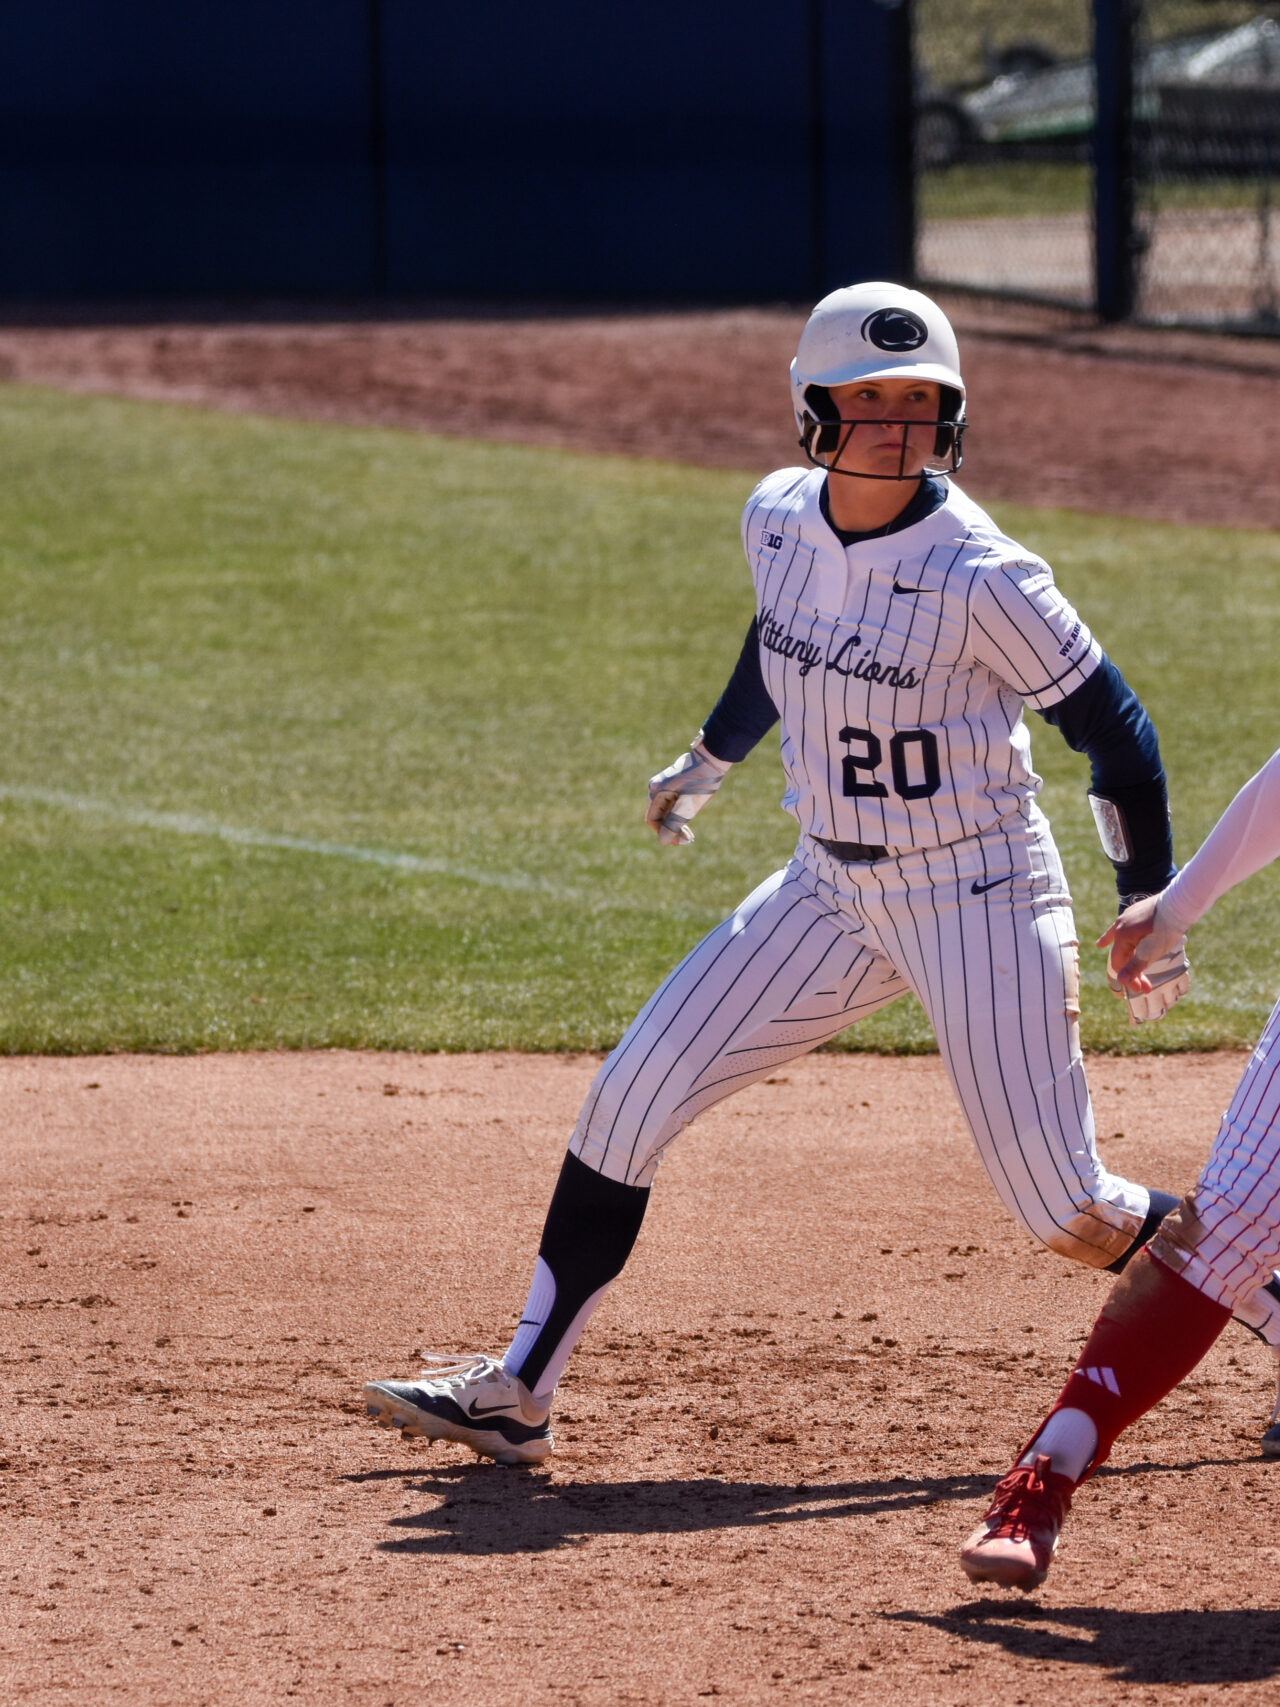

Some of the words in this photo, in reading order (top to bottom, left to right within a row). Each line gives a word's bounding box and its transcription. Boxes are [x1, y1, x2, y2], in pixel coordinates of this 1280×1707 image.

[825, 635, 921, 689] Lions
[1058, 639, 1075, 657] WE
[838, 726, 942, 800] 20
